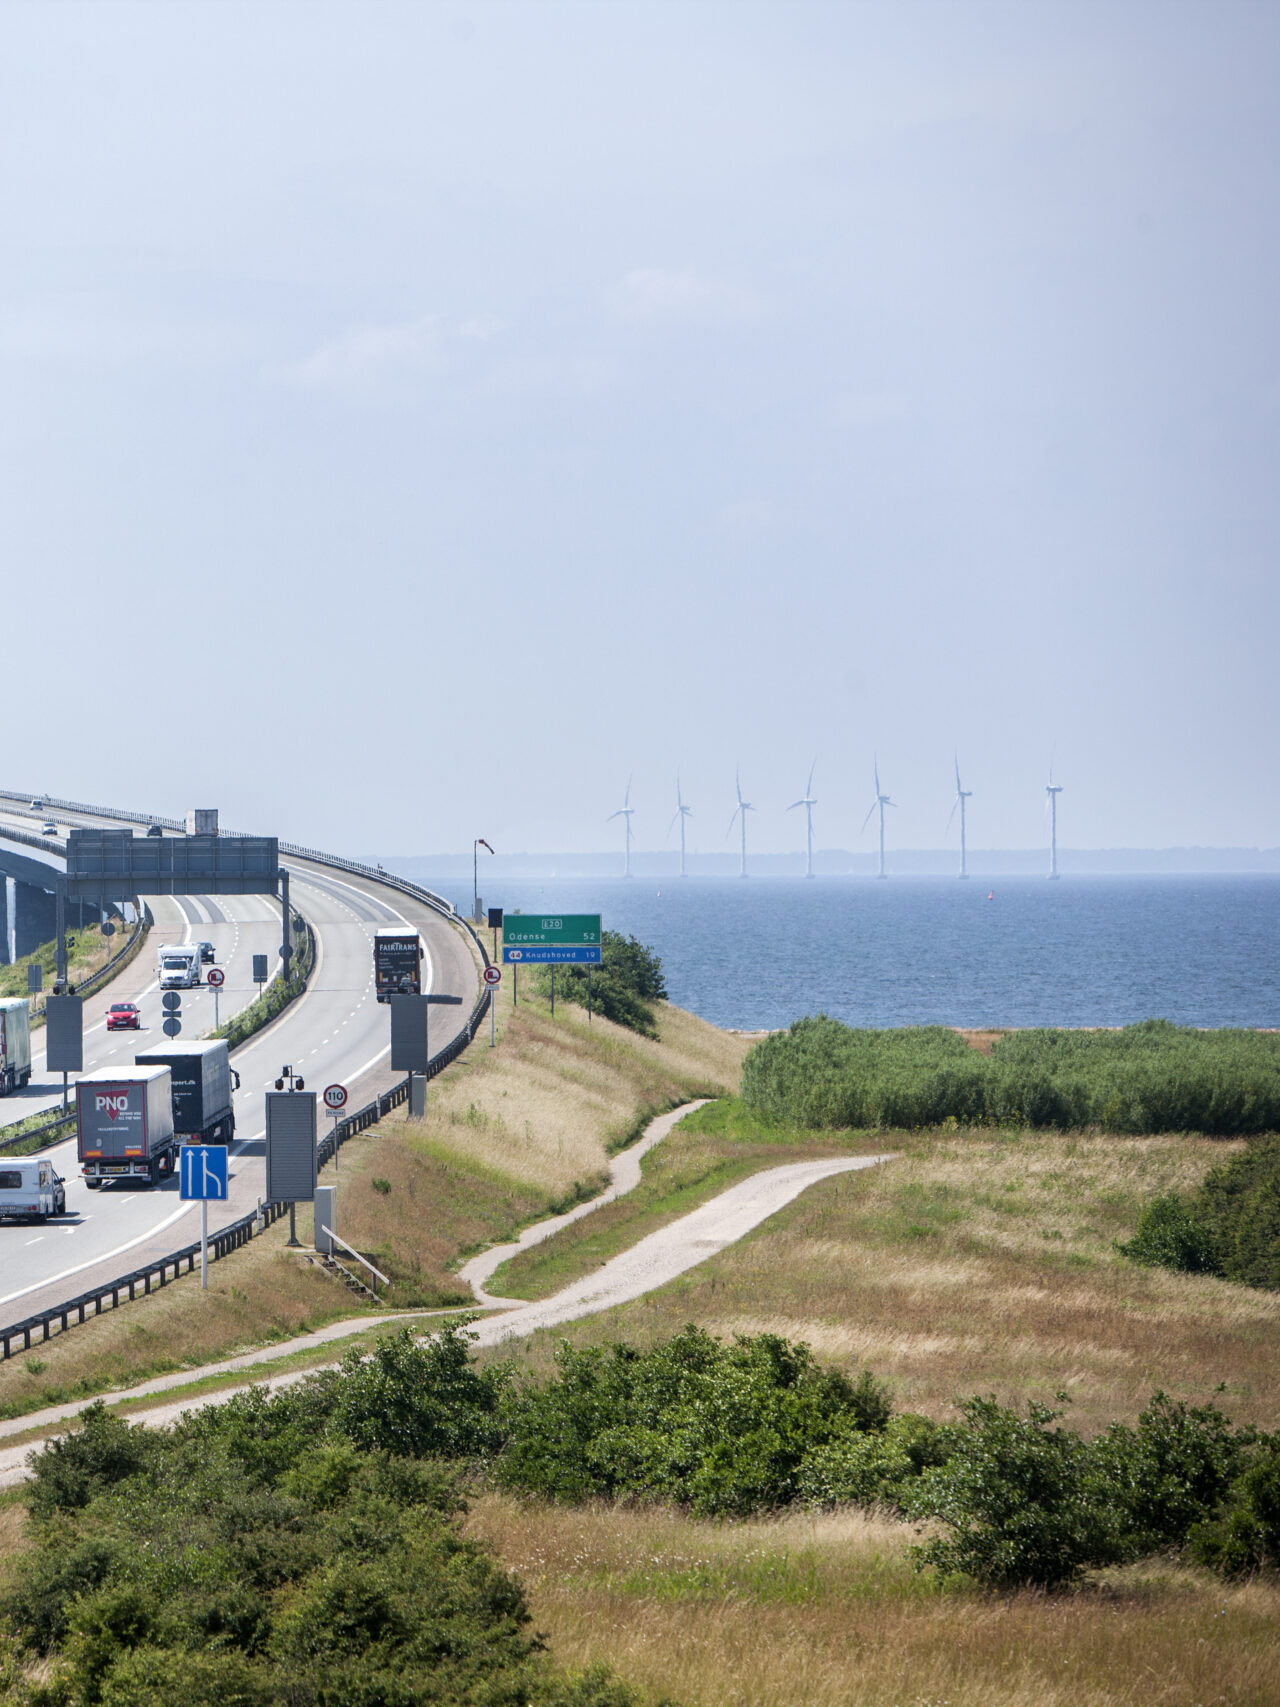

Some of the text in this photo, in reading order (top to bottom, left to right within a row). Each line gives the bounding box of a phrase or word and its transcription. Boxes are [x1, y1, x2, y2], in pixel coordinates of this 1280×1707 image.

[509, 932, 596, 941] Odense 52
[379, 942, 417, 952] FAIRTRANS
[510, 951, 521, 959] 44
[328, 1091, 344, 1101] 110
[95, 1096, 129, 1111] PNO
